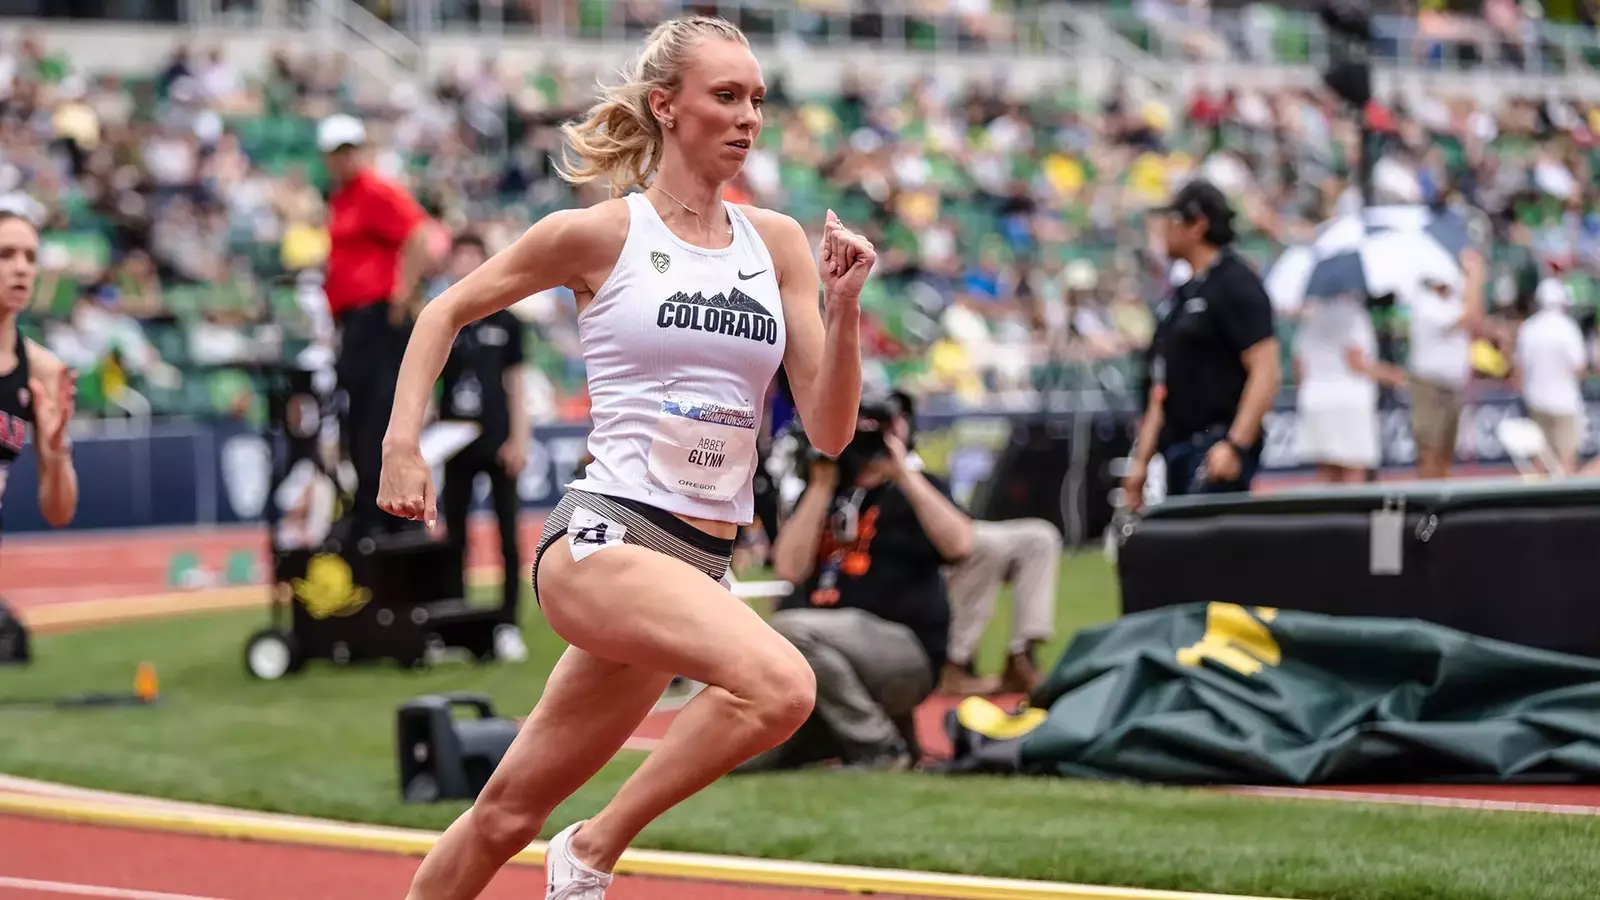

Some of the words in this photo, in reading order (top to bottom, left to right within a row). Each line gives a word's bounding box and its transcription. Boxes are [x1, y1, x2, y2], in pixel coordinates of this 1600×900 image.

[656, 302, 777, 345] COLORADO
[697, 438, 726, 452] ABBEY
[688, 449, 725, 468] GLYNN
[678, 479, 716, 491] OREGON
